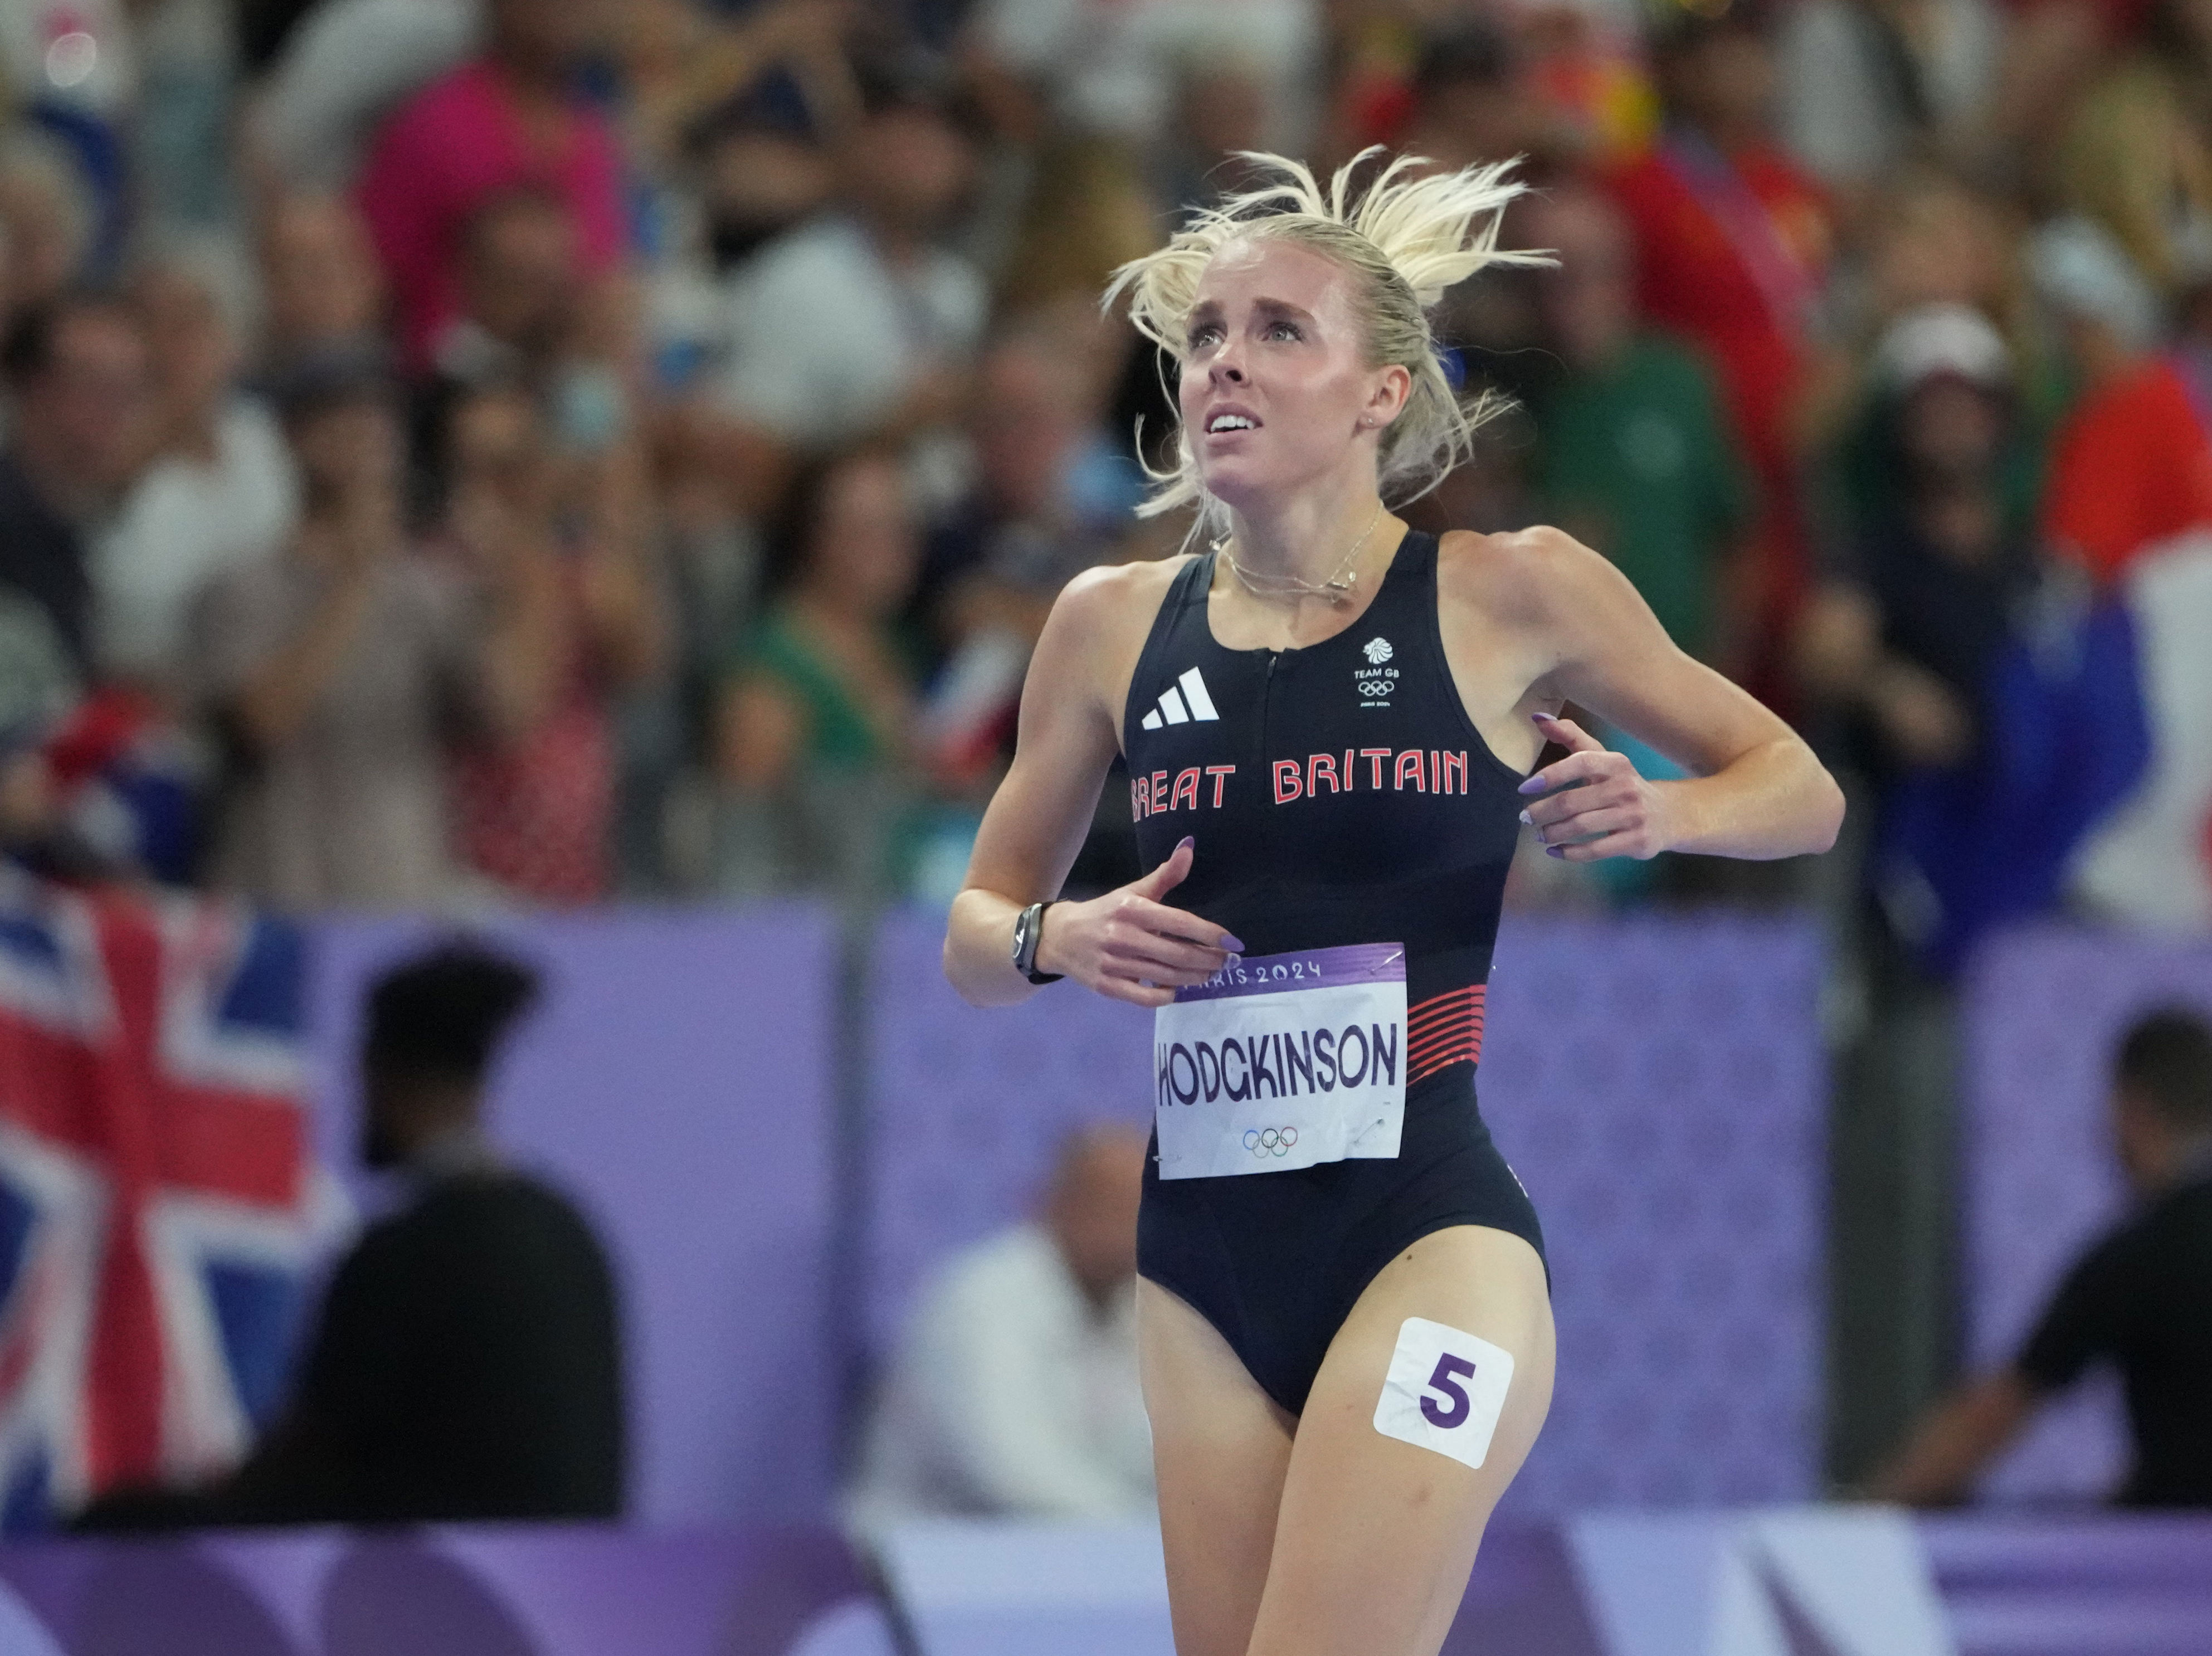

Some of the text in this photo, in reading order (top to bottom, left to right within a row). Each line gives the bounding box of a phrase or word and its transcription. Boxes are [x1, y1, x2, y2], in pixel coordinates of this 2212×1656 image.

[1355, 668, 1400, 679] TEAM GB
[1273, 748, 1468, 805] BRITAIN
[1256, 961, 1322, 983] 2024
[1158, 1023, 1397, 1106] HODGKINSON
[1420, 1352, 1477, 1429] 5
